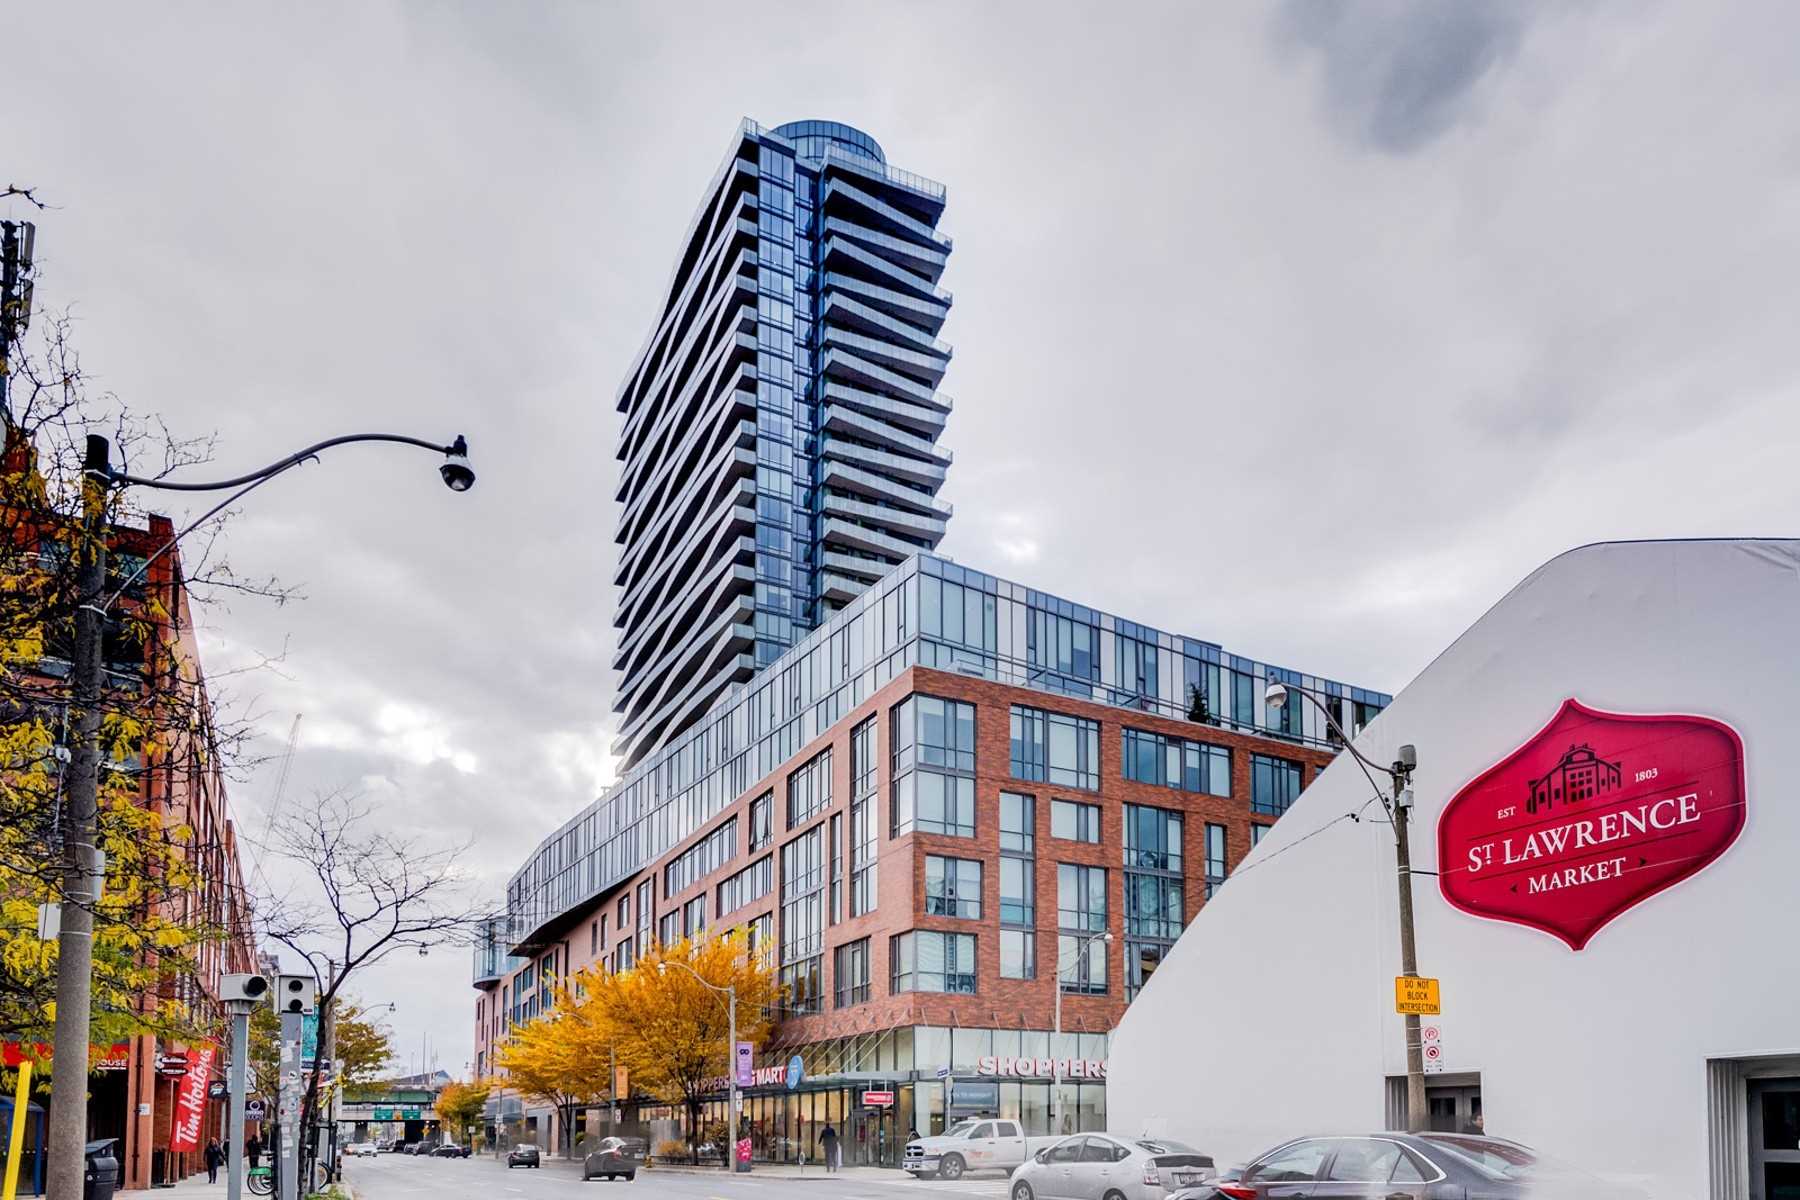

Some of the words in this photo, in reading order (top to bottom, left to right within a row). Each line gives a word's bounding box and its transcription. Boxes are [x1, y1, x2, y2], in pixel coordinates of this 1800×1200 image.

[1634, 767, 1658, 783] 1803
[1497, 806, 1517, 820] EST
[1503, 792, 1702, 865] LAWRENCE
[1528, 857, 1627, 894] MARKET
[1404, 980, 1413, 988] DO
[1417, 980, 1429, 989] NOT
[1407, 990, 1428, 1000] BLOCK
[1399, 1001, 1438, 1012] INTERSECTION
[757, 1066, 784, 1084] MART
[978, 1055, 1106, 1079] SHOPPERS
[179, 1049, 212, 1112] Hortons
[176, 1113, 201, 1144] Tim
